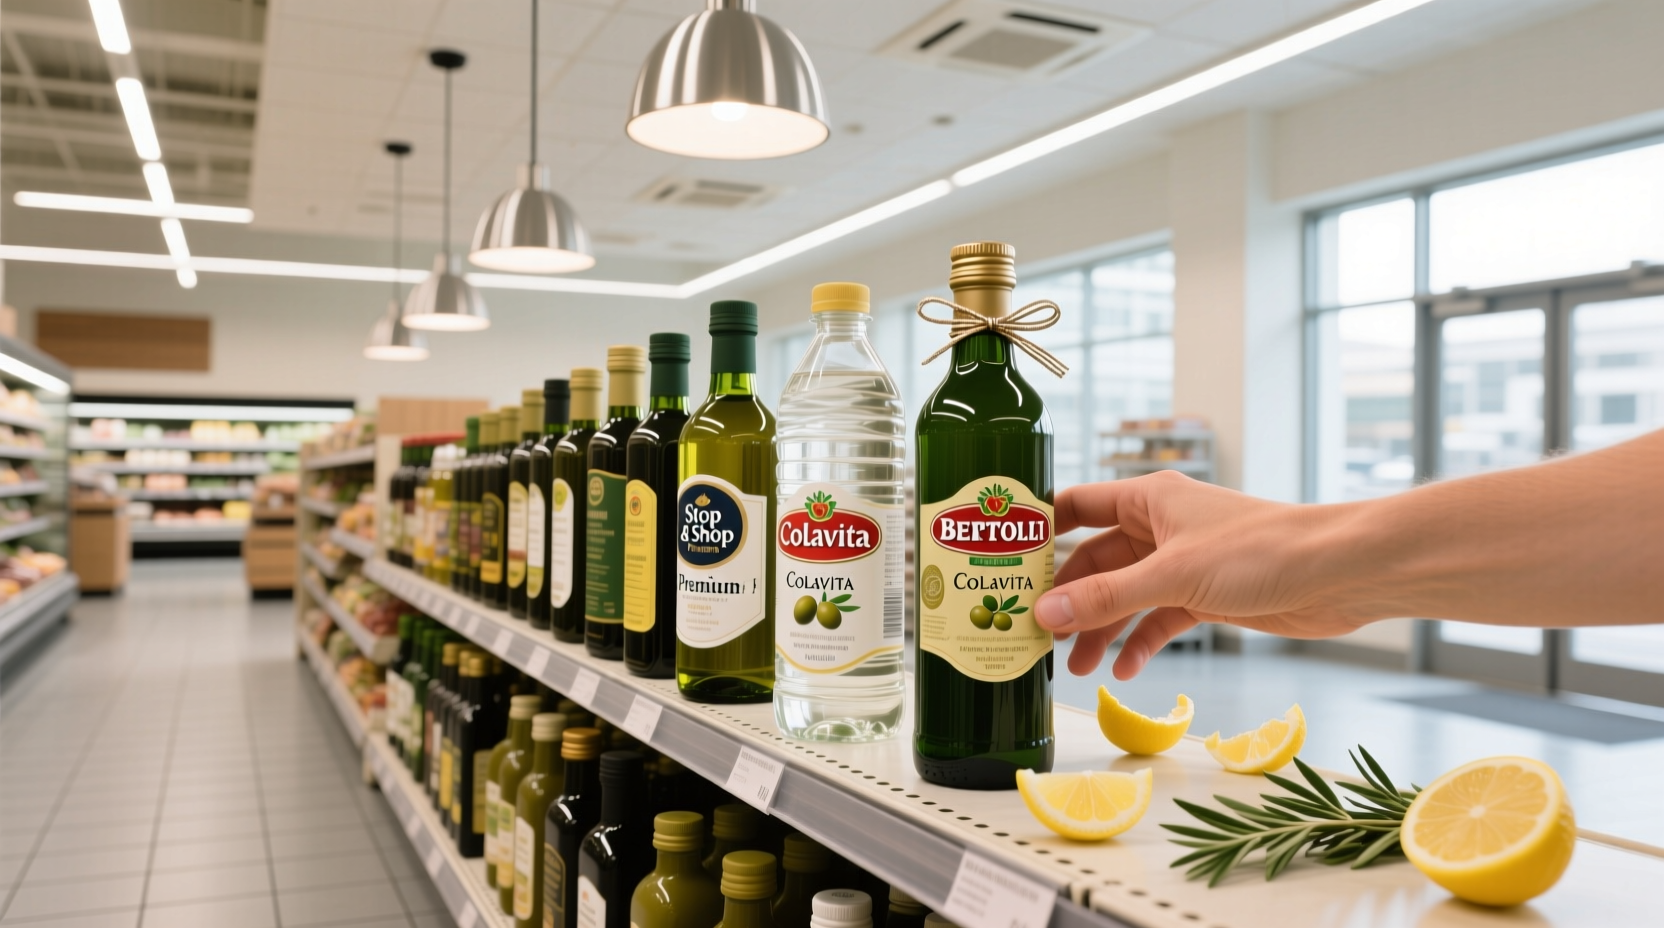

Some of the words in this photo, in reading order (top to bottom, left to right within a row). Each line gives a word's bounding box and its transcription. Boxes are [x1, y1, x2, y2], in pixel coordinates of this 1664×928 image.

[685, 503, 722, 529] Stop
[780, 521, 871, 548] Colavita
[940, 517, 1045, 542] BERTOLLI
[678, 573, 740, 594] Premium
